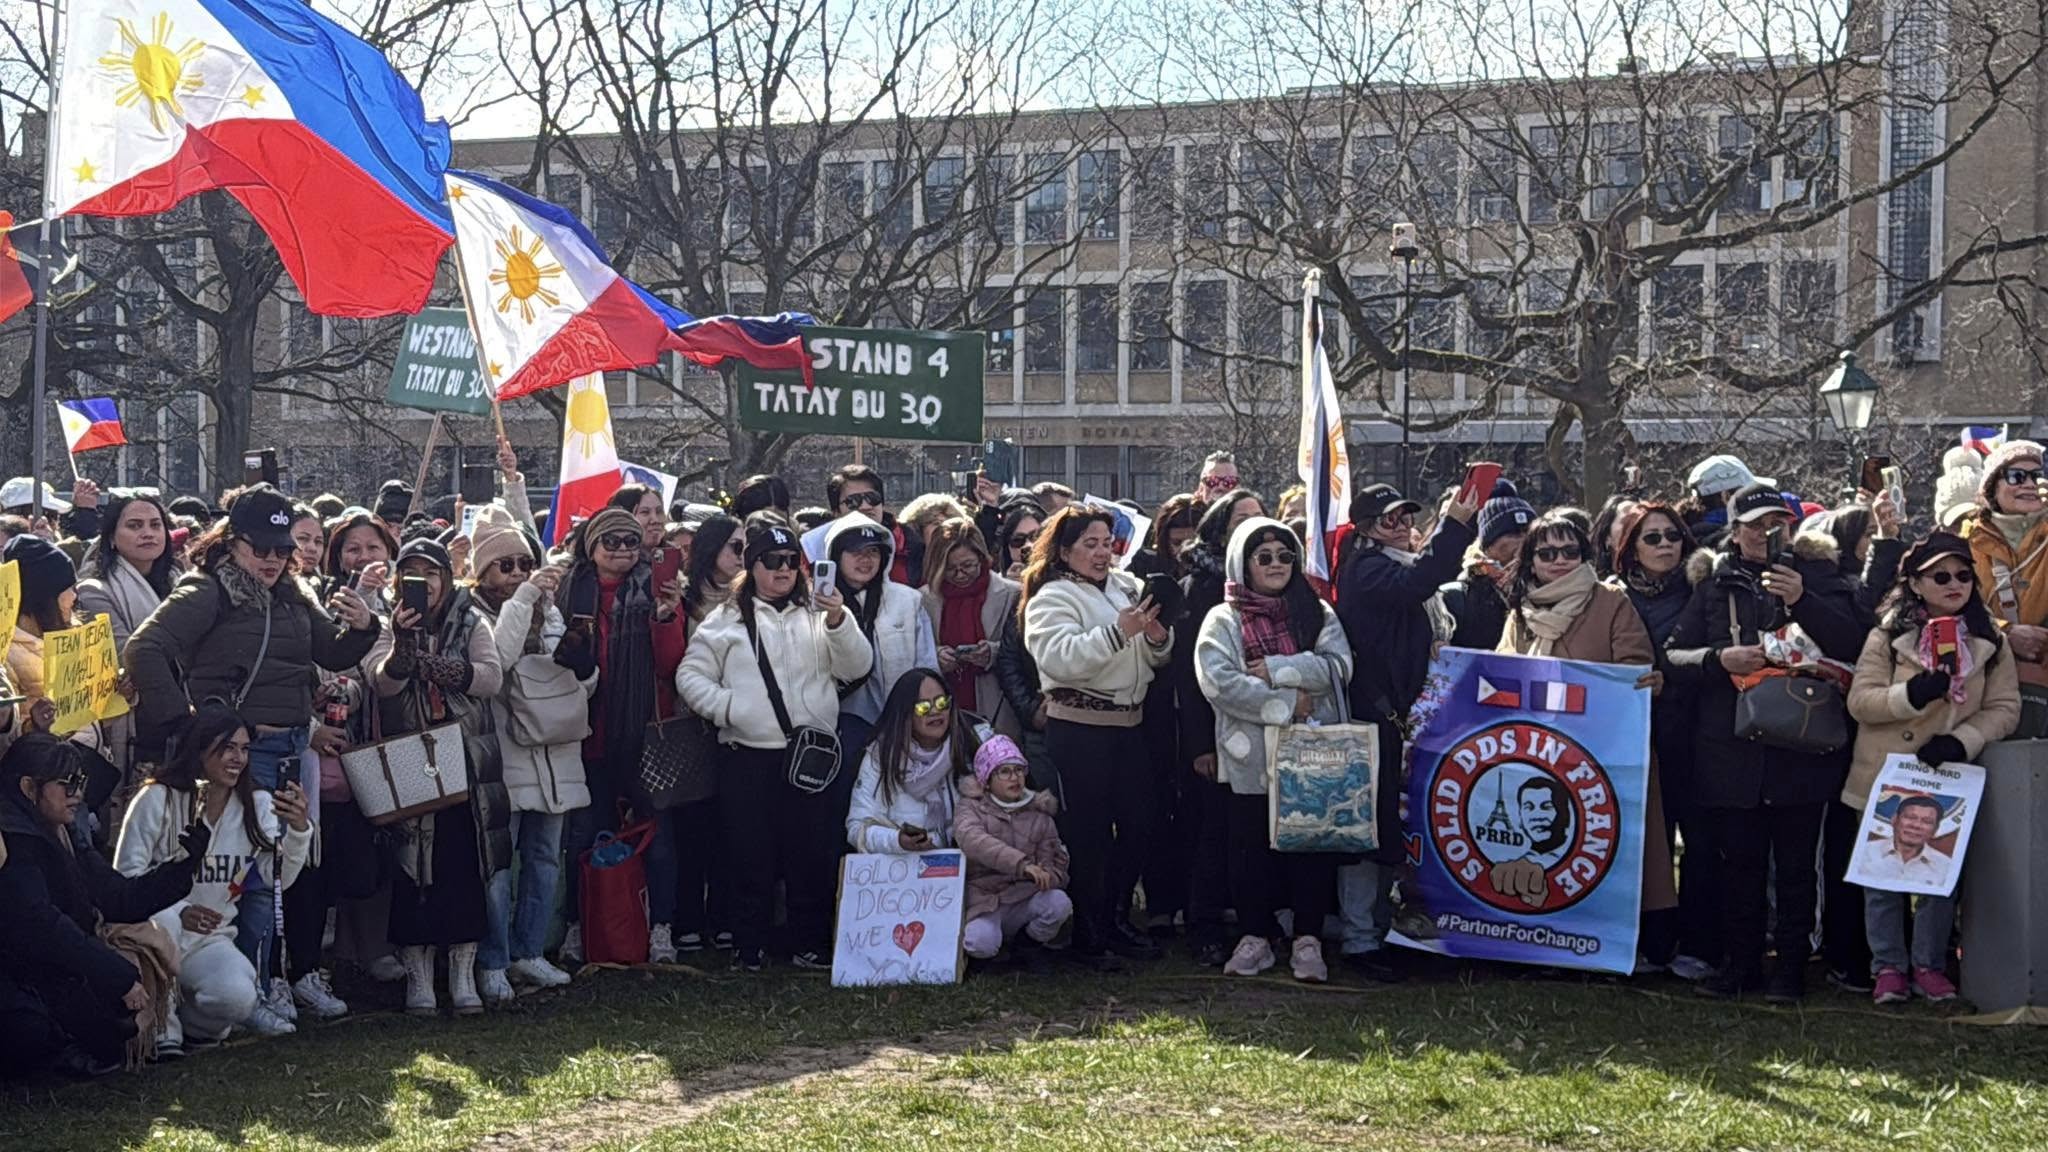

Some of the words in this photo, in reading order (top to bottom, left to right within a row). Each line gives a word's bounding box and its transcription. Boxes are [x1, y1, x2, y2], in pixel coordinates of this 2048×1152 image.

[809, 338, 912, 375] STAND
[927, 347, 950, 378] 4
[405, 363, 447, 394] TATAY
[465, 369, 485, 398] 30
[753, 383, 841, 417] TATAY
[852, 389, 886, 419] DU
[901, 392, 942, 425] 30
[987, 422, 1049, 440] NSTEN
[269, 510, 290, 526] alo
[1452, 728, 1517, 775] DDS
[1527, 731, 1568, 766] IN
[1898, 761, 1930, 774] BRING
[1911, 777, 1942, 790] HOME
[1434, 777, 1485, 882] SOLID
[1475, 825, 1525, 847] PRRD
[1555, 760, 1612, 898] FRANCE
[846, 859, 909, 887] LOLO
[855, 885, 953, 920] DIGONG
[846, 925, 885, 954] WE
[1436, 914, 1599, 954] #PartnerForChange
